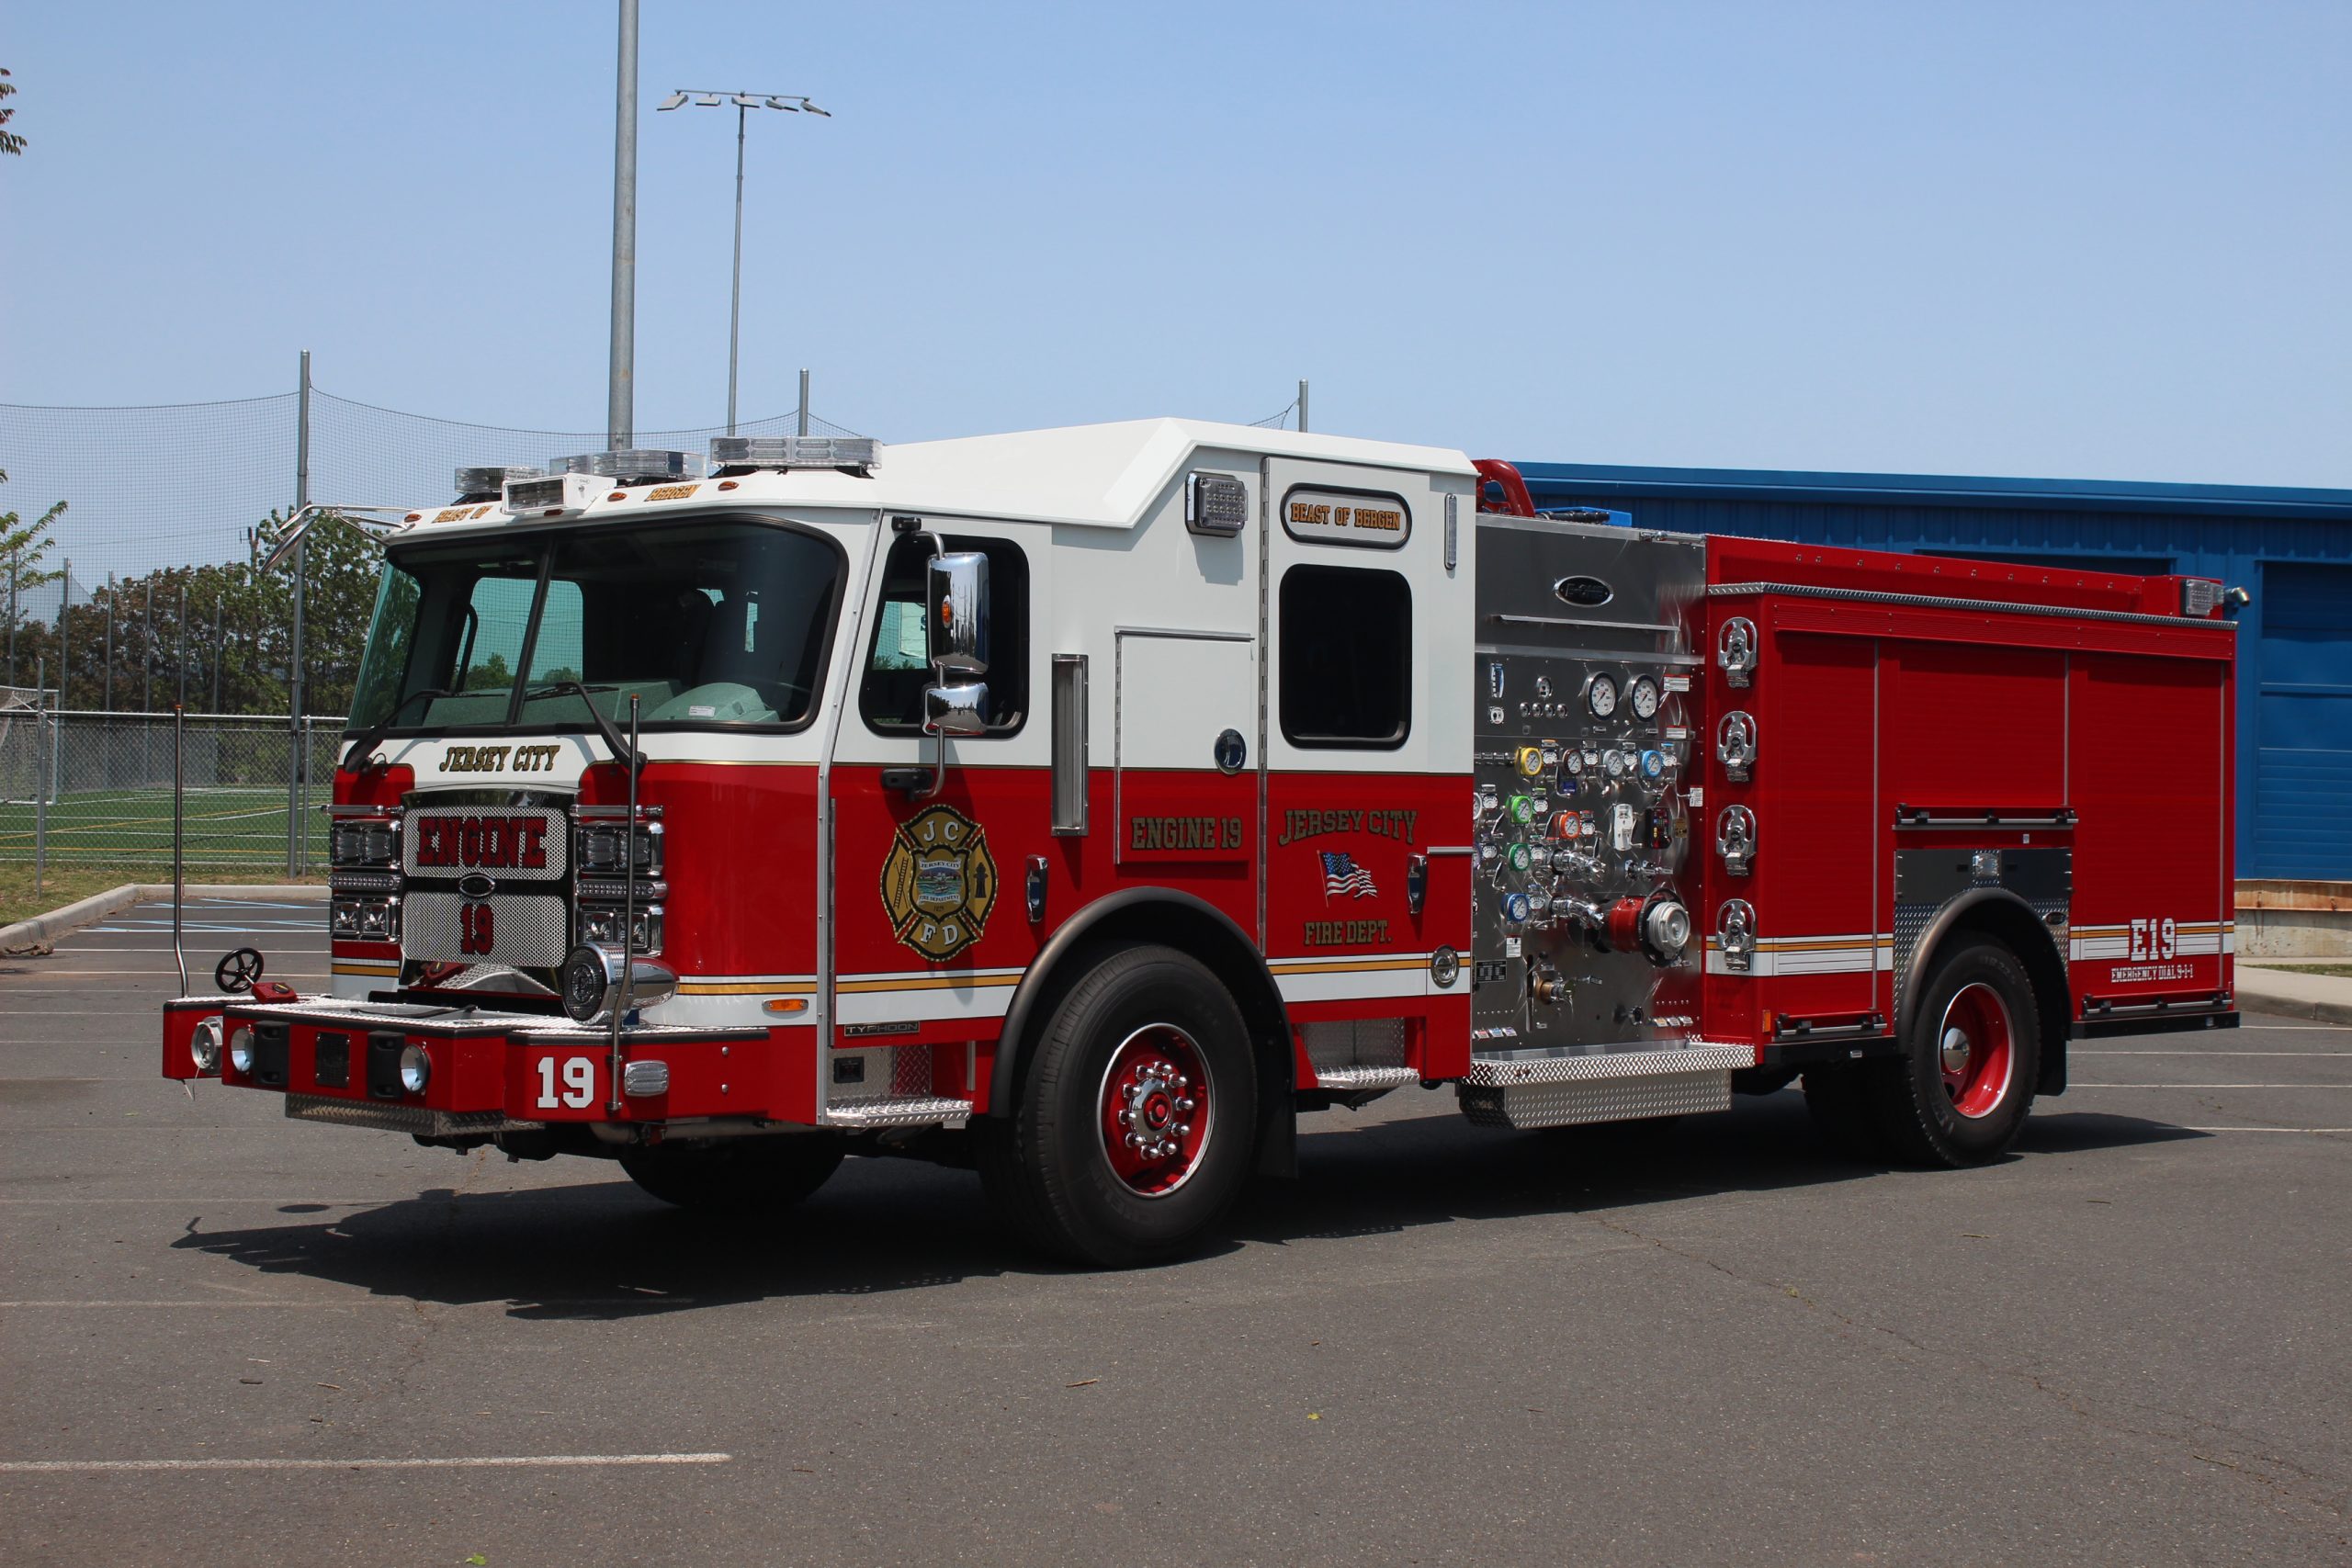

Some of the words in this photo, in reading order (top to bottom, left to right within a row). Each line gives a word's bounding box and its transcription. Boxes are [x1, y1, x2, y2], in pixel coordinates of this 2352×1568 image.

[1291, 502, 1330, 525] BEAST
[1334, 507, 1351, 526] OF
[1354, 508, 1401, 531] BERGEN
[439, 746, 512, 772] JERSEY
[513, 745, 560, 772] CITY
[416, 816, 548, 869] ENGINE
[1131, 817, 1216, 850] ENGINE
[1221, 817, 1242, 850] 19
[1279, 809, 1364, 846] JERSEY
[1368, 809, 1418, 844] CITY
[460, 904, 494, 955] 19
[1305, 921, 1342, 945] FIRE
[1345, 919, 1393, 944] DEPT.
[2131, 919, 2176, 962] E19
[2111, 965, 2157, 983] EMERGENCY
[2158, 964, 2177, 980] DIAL
[846, 1023, 918, 1034] TYPHOON
[537, 1056, 594, 1109] 19
